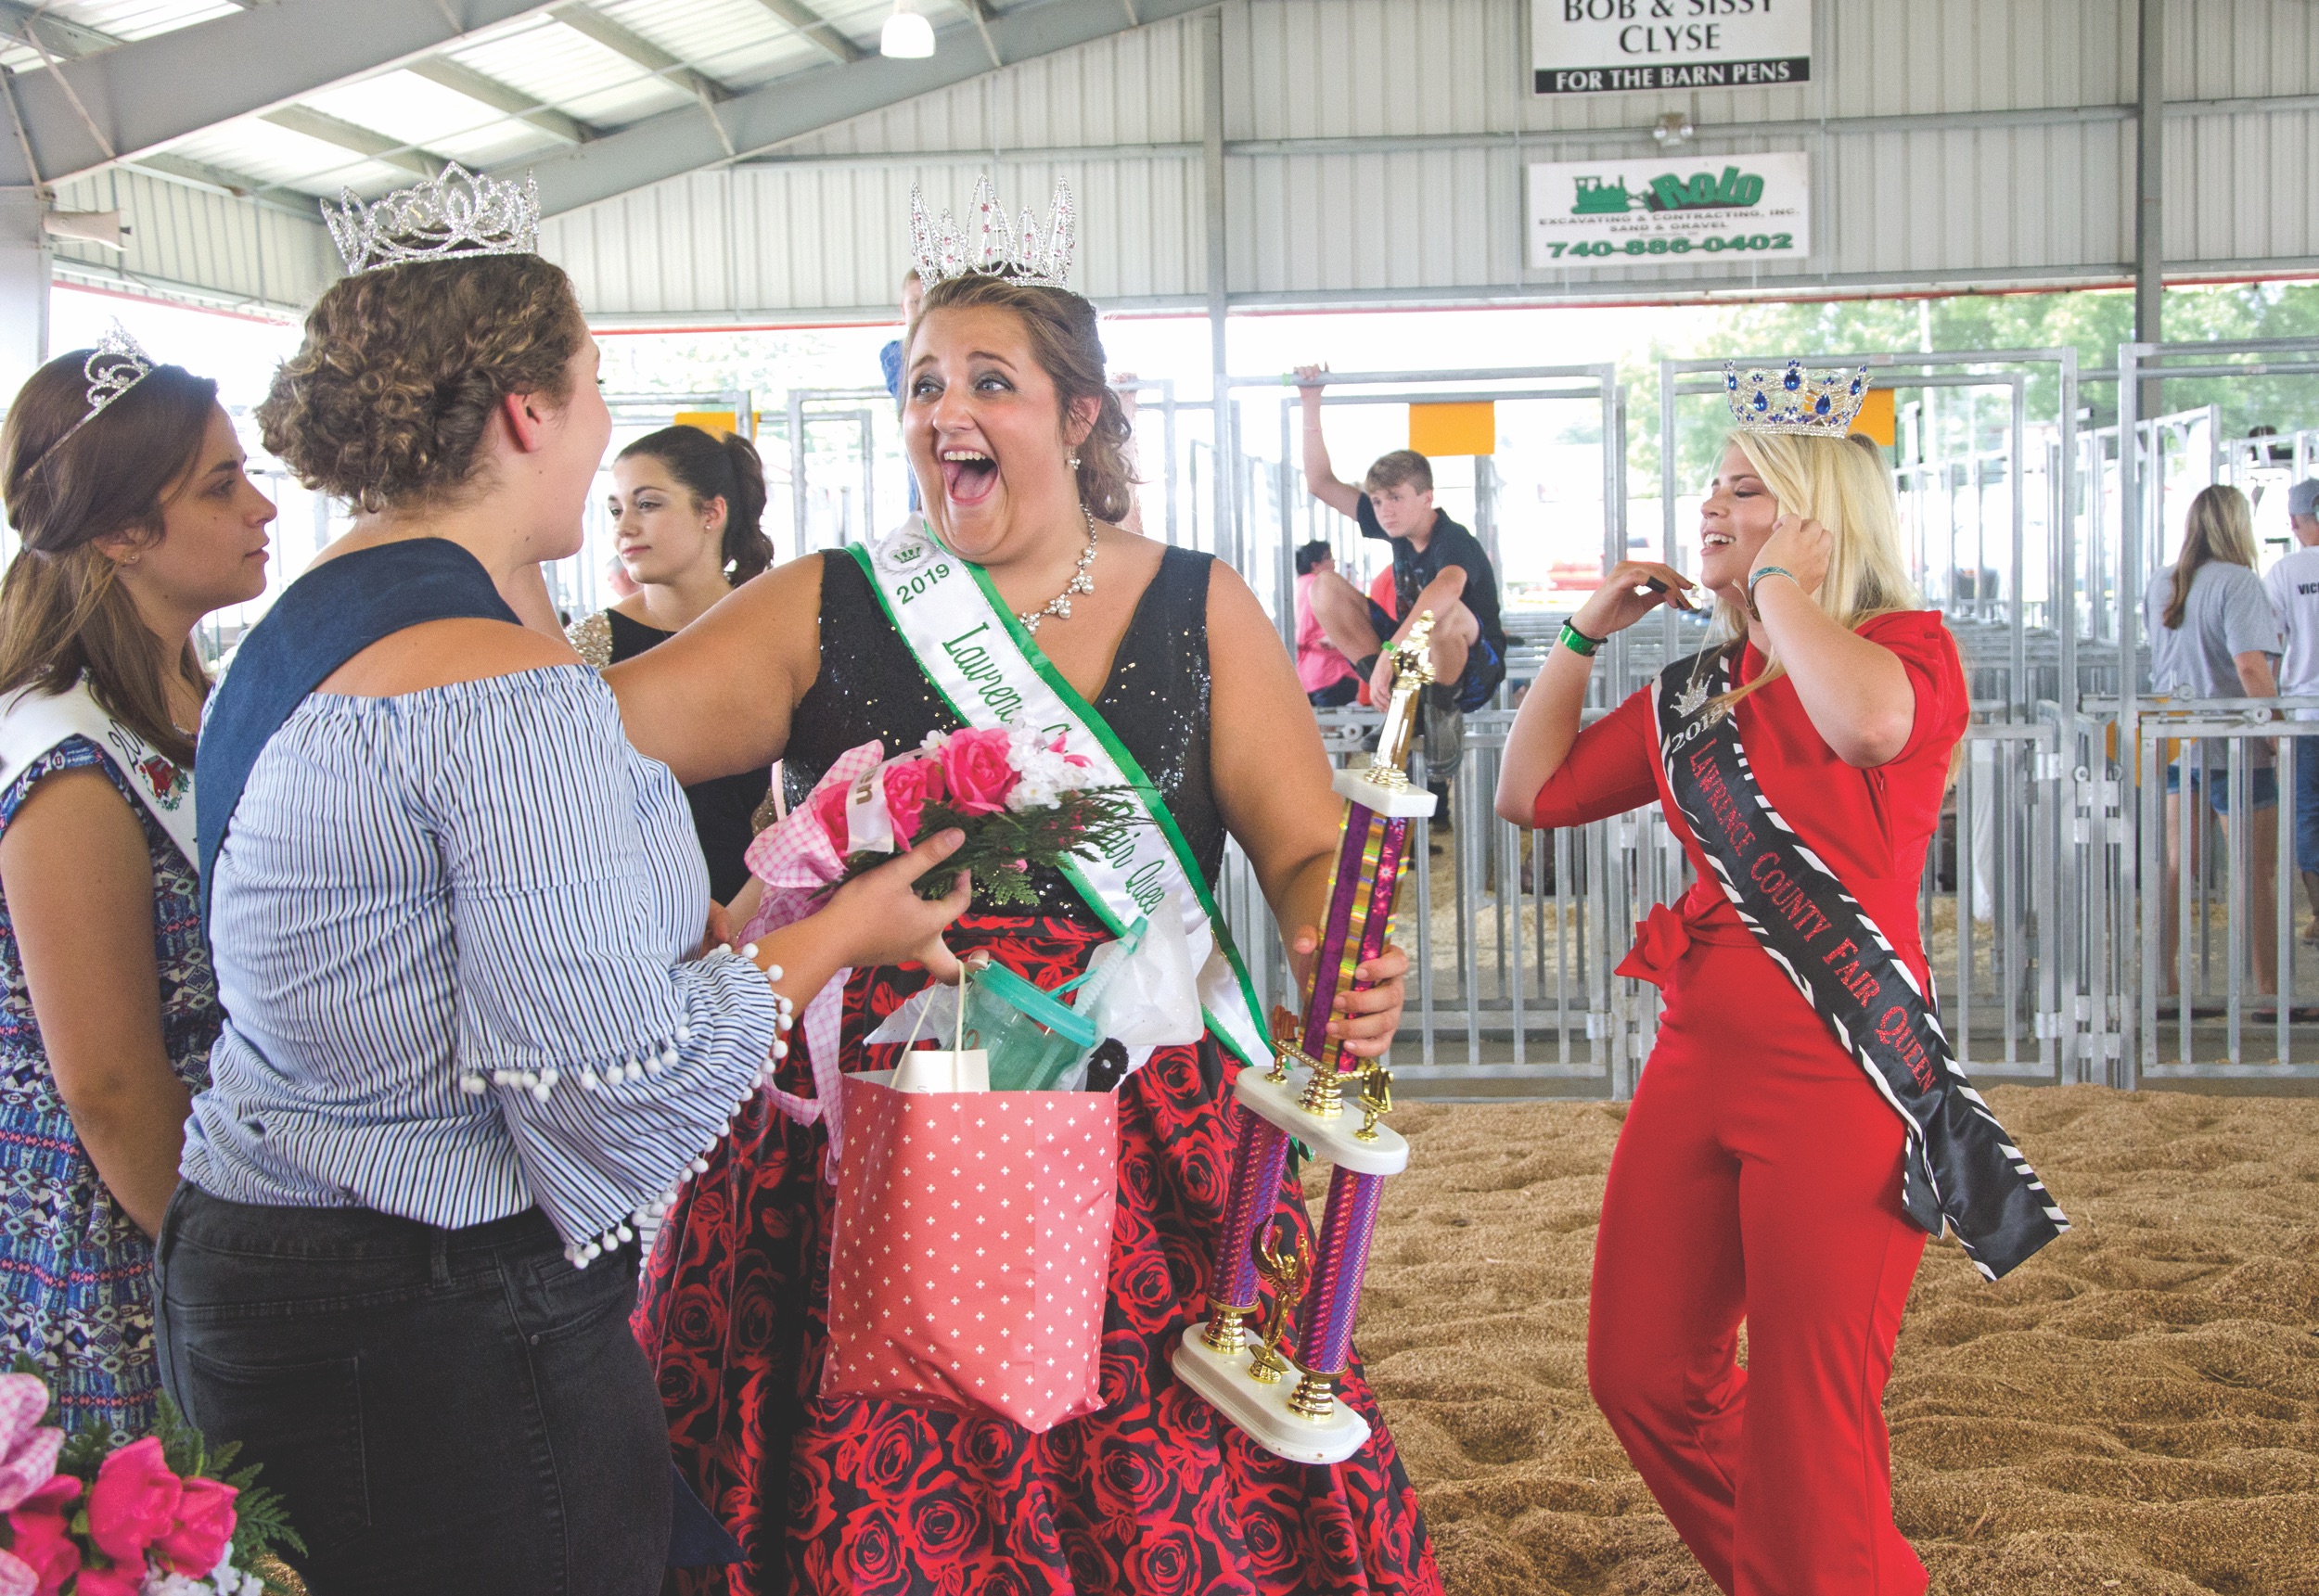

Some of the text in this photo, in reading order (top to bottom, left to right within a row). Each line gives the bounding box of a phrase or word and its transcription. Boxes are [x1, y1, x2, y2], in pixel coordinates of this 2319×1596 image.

[1564, 0, 1636, 21] BOB
[1650, 0, 1674, 18] &
[1620, 23, 1721, 54] CLYSE
[1556, 61, 1791, 91] FOR THE BARN PENS
[1540, 215, 1631, 224] EXCAVATING
[1769, 207, 1800, 215] INC.
[1609, 223, 1648, 232] SAND
[1671, 221, 1728, 229] GRAVEL
[1546, 232, 1793, 258] 740-886-0402
[896, 563, 950, 605] 2019
[2298, 582, 2319, 594] VIC
[1125, 860, 1165, 915] Quee
